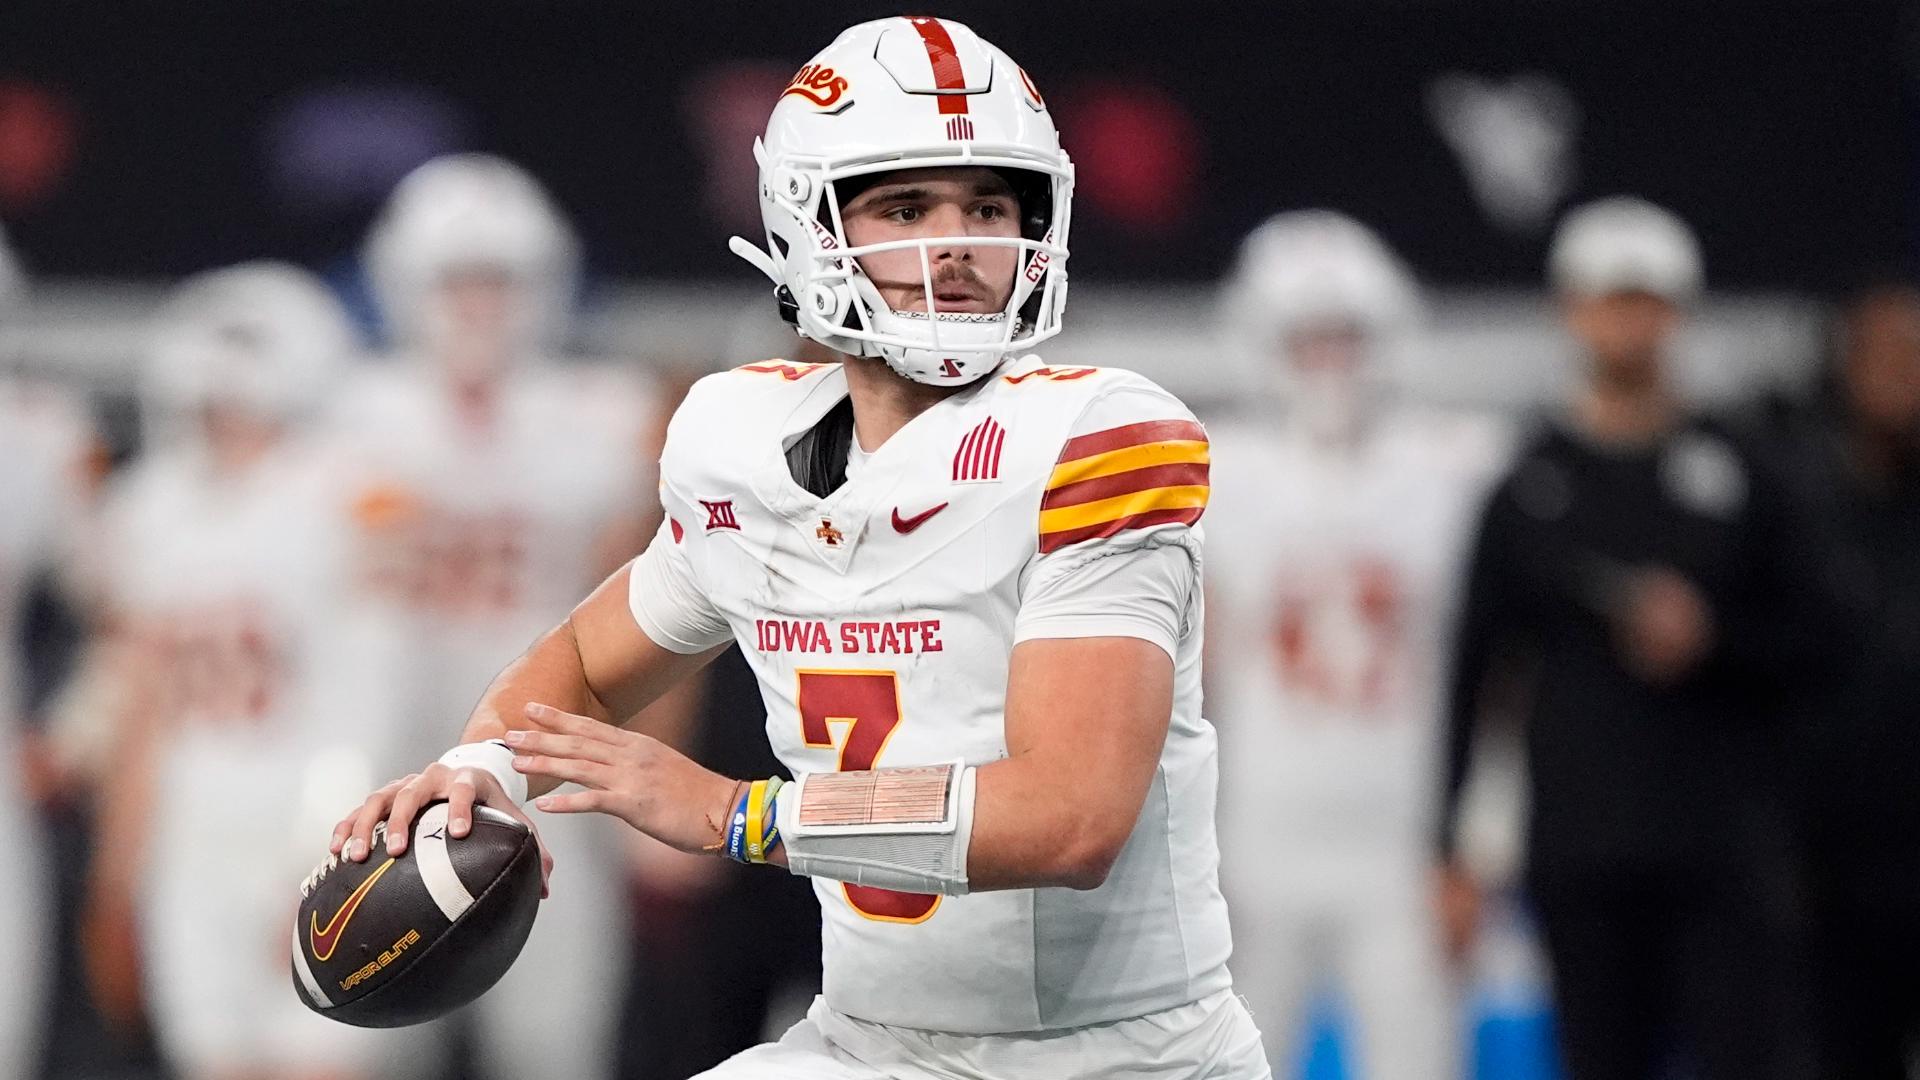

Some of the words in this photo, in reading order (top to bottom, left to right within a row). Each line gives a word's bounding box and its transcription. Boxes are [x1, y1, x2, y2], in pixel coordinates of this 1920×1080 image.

[756, 619, 832, 653] IOWA
[840, 620, 943, 654] STATE
[339, 961, 382, 991] VAPOR
[377, 929, 420, 968] ELITE
